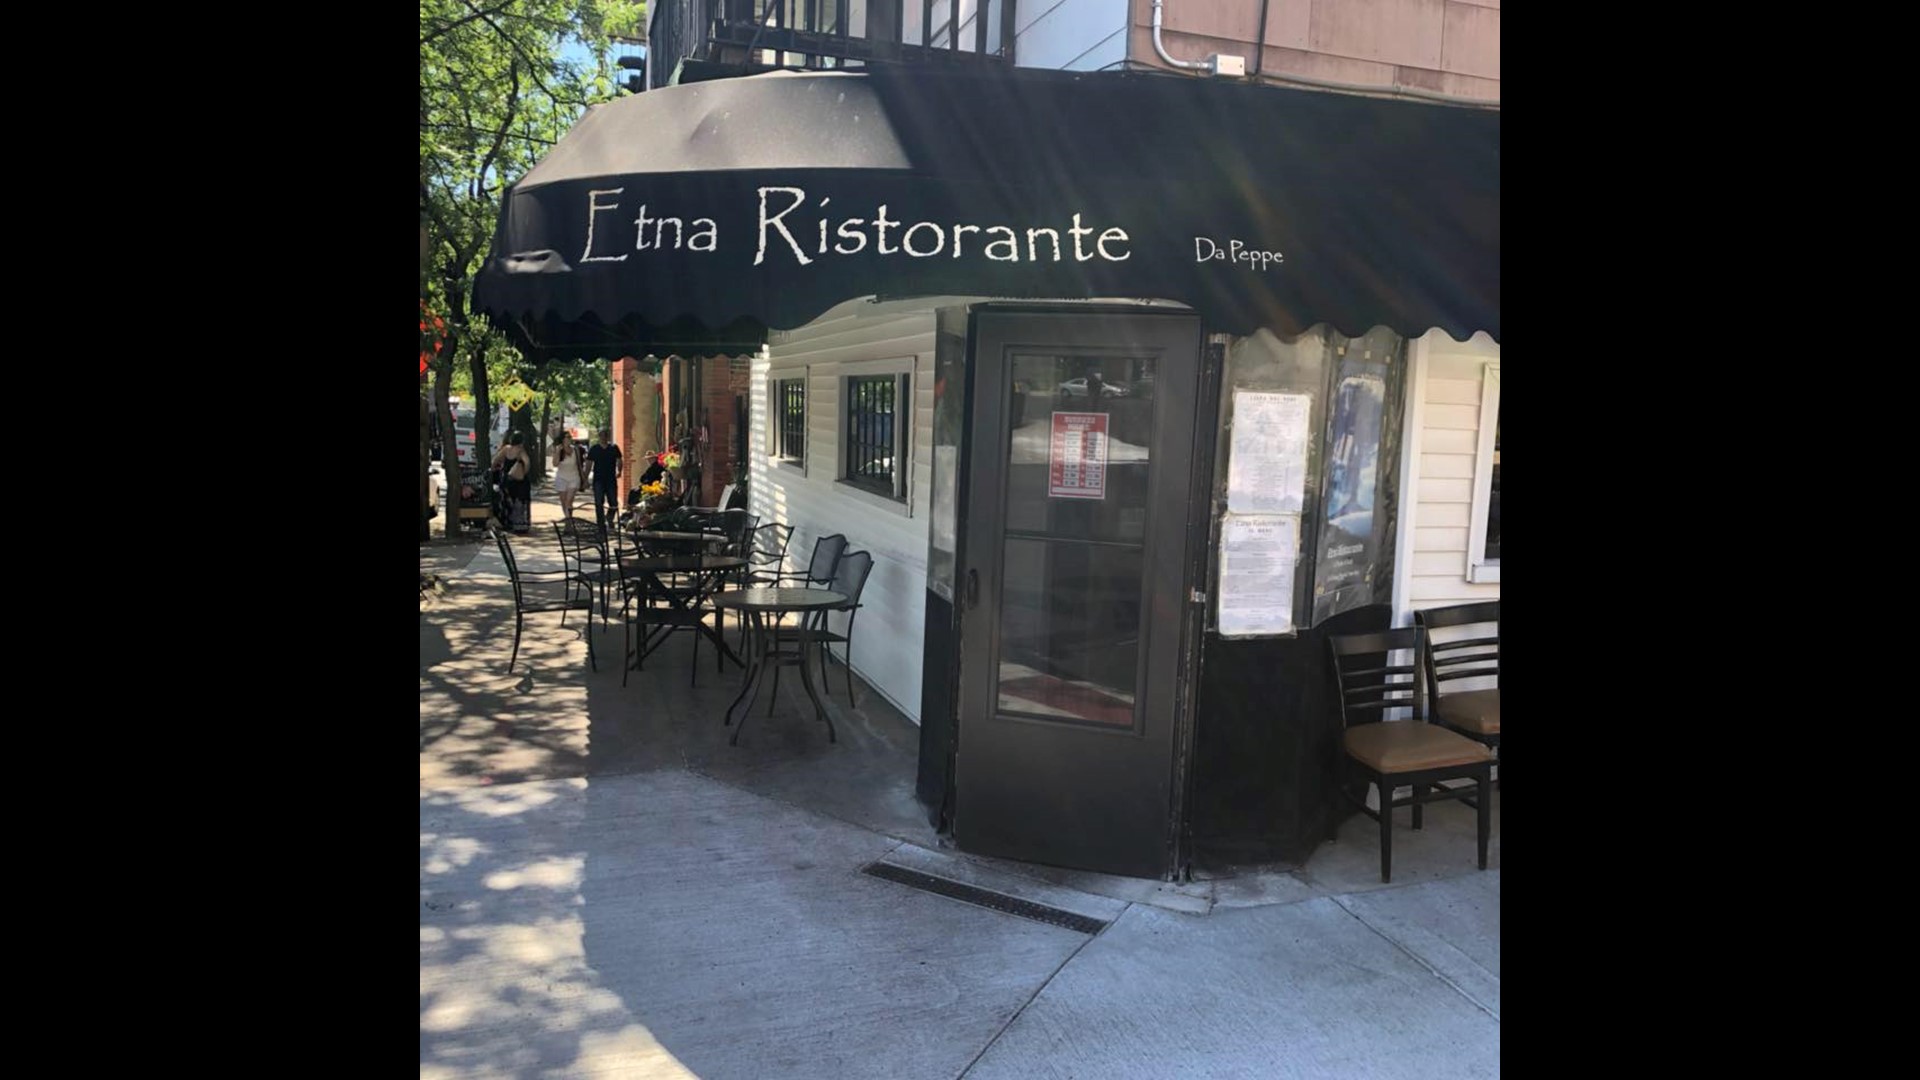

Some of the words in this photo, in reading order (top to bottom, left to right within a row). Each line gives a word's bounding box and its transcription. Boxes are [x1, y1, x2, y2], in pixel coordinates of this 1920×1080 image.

[579, 187, 718, 264] Etna
[753, 186, 1131, 266] Ristorante
[1194, 236, 1226, 263] Da
[1229, 239, 1285, 271] Peppe
